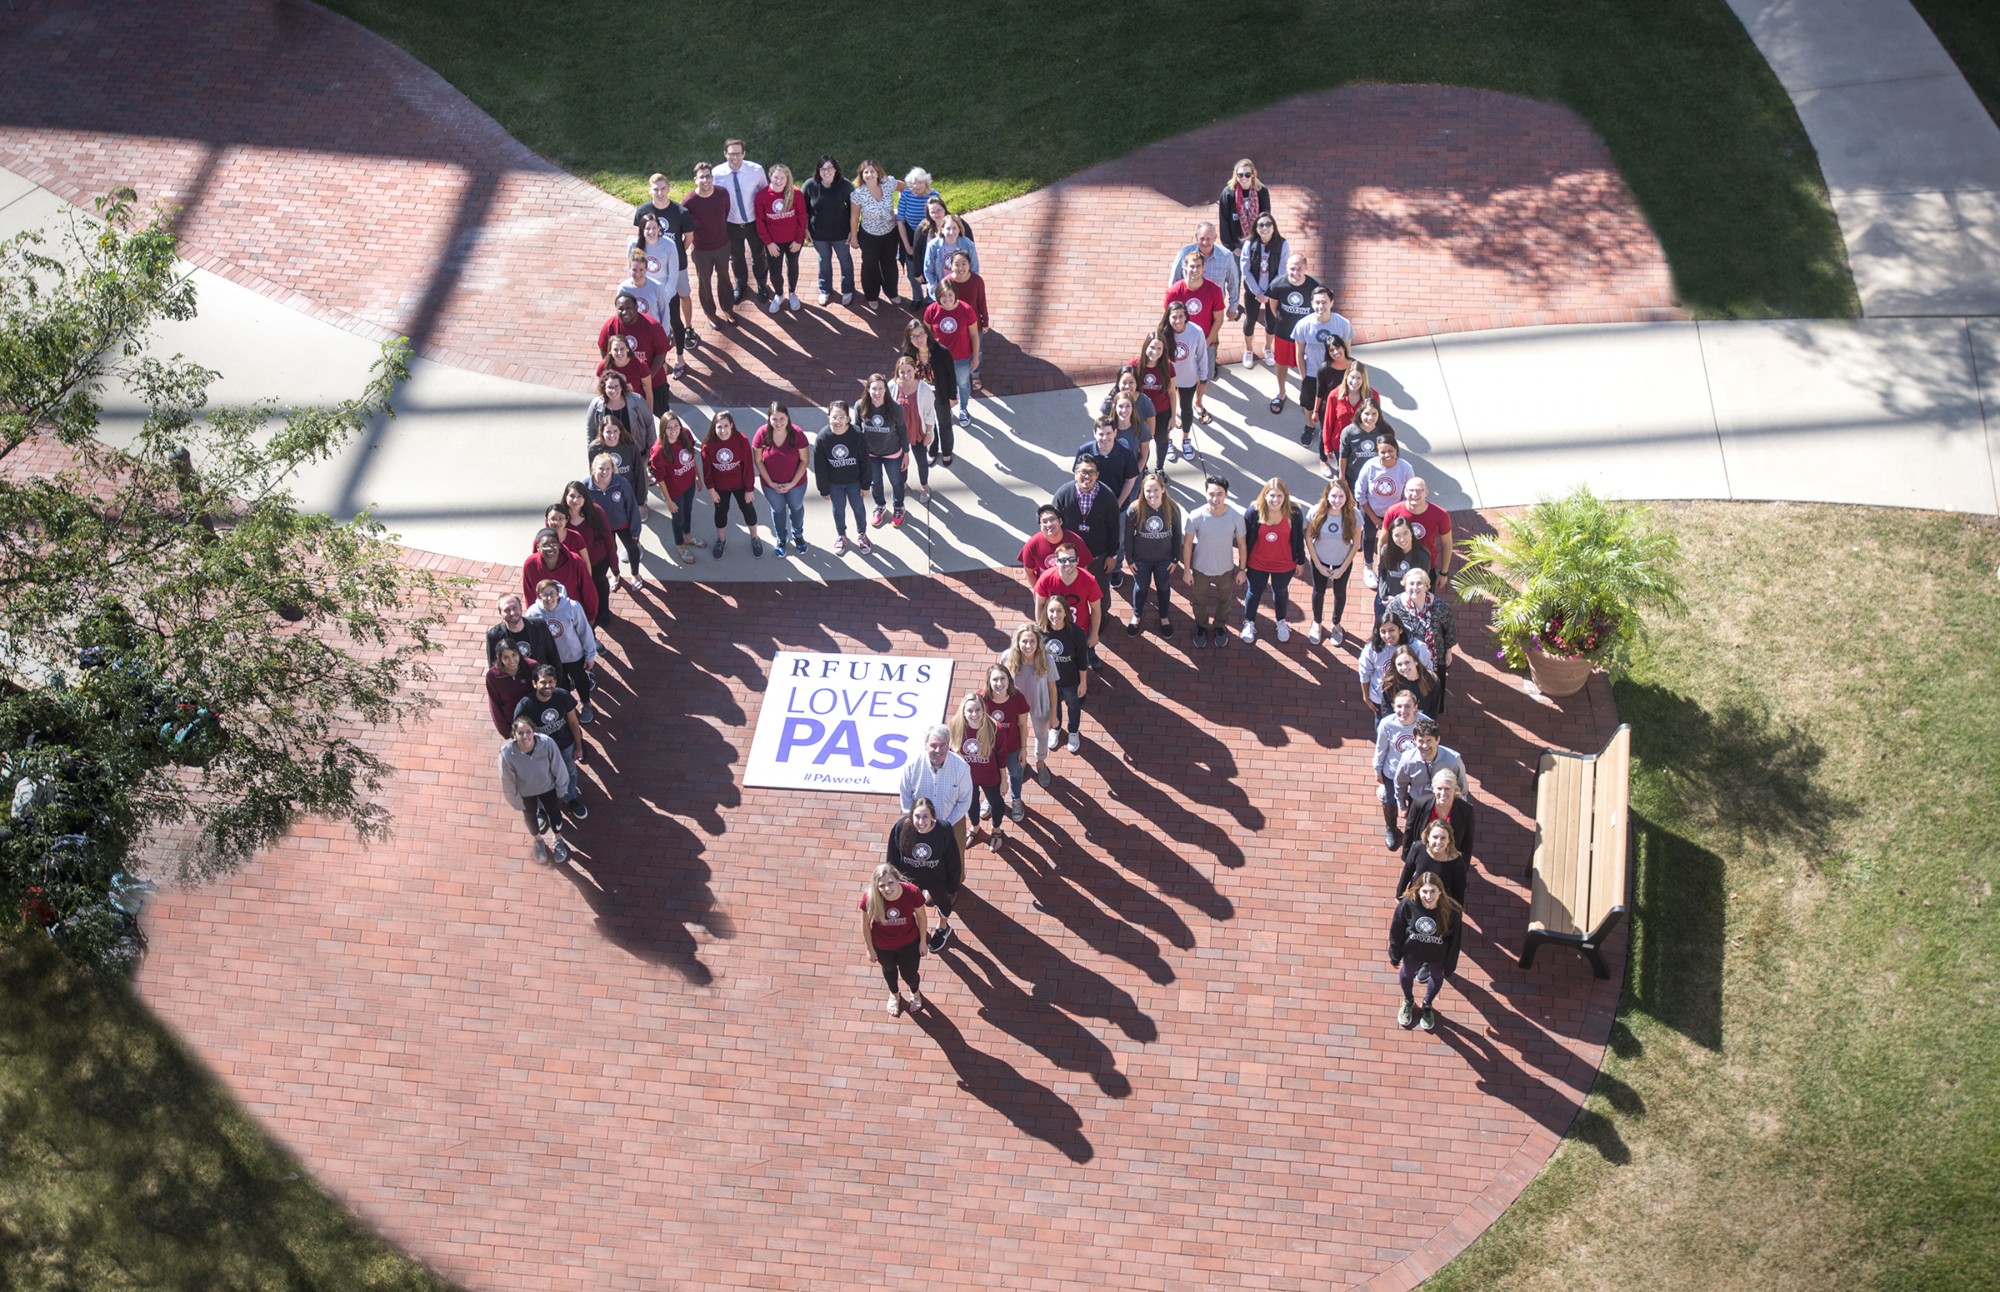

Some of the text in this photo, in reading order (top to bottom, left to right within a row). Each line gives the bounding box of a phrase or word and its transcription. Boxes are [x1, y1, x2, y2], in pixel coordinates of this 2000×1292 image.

[790, 658, 931, 683] RFUMS
[787, 686, 919, 719] LOVES
[775, 716, 909, 770] PAs
[803, 772, 871, 785] #PAweek
